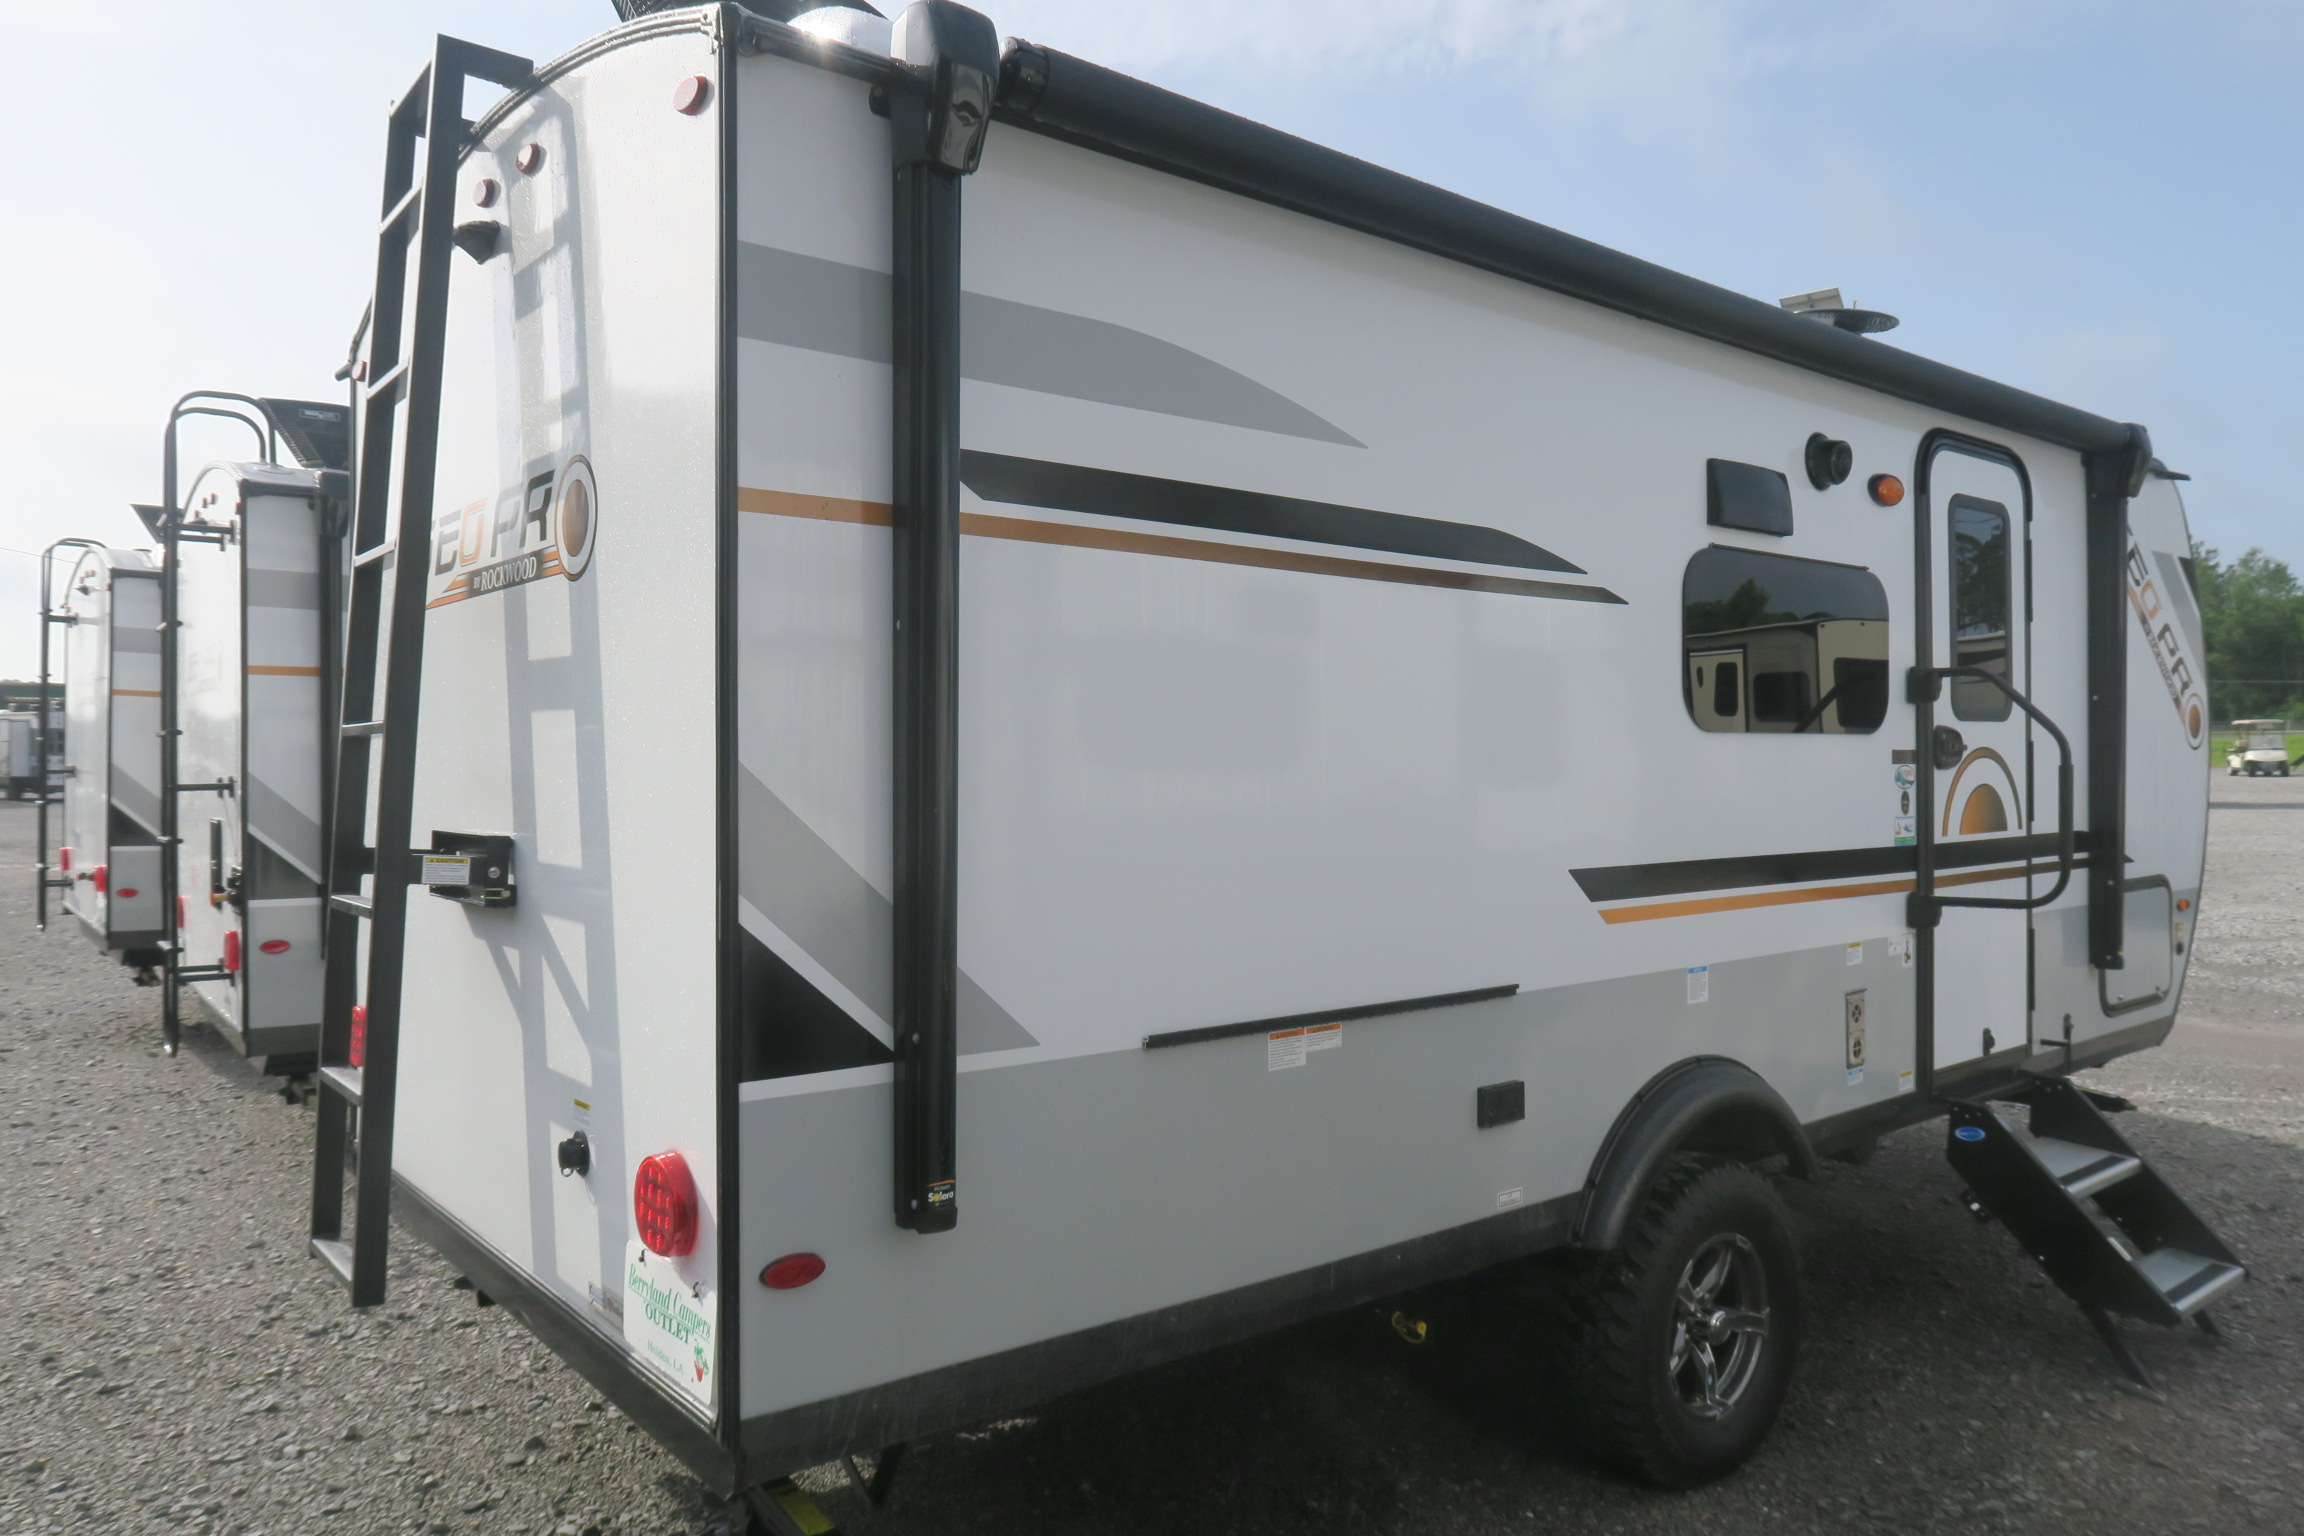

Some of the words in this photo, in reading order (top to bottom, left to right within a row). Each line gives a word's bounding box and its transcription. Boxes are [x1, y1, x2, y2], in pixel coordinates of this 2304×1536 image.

[473, 575, 481, 590] BY
[481, 556, 537, 592] ROCKWOOD
[928, 1191, 953, 1201] Solera
[628, 1263, 673, 1311] Berryland
[673, 1291, 711, 1340] Campers
[644, 1302, 692, 1344] OUTLET
[672, 1358, 684, 1375] LA
